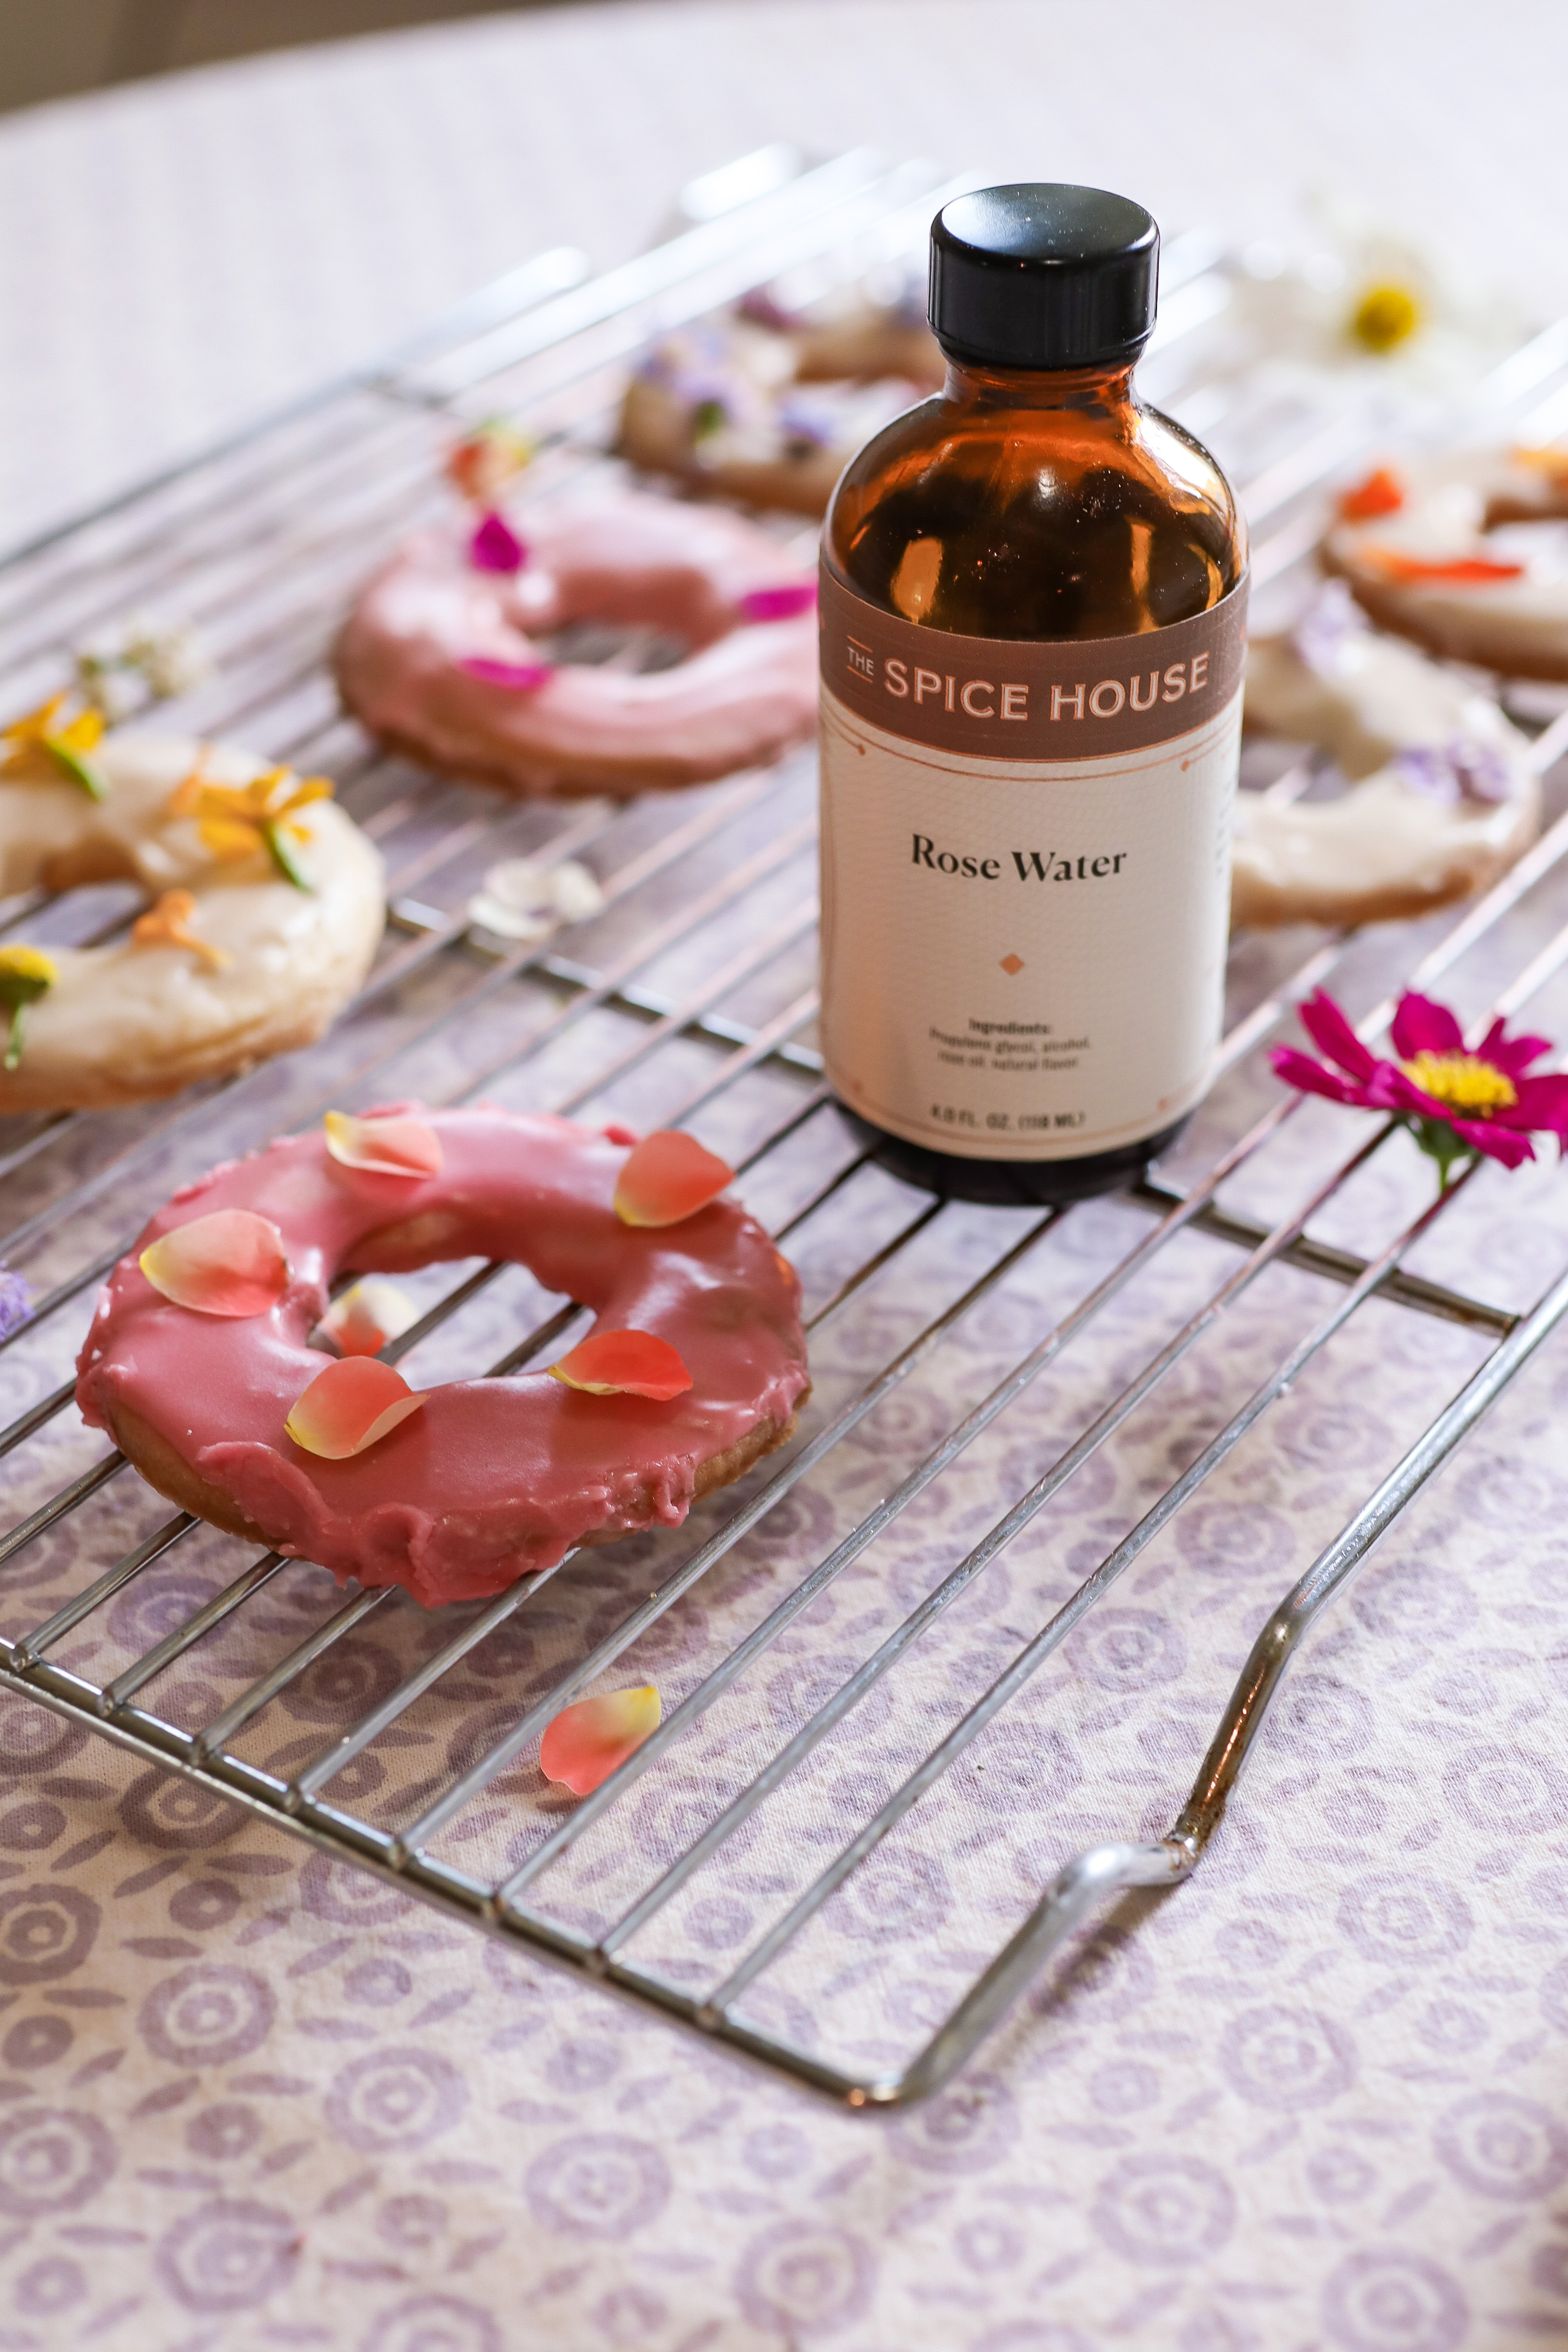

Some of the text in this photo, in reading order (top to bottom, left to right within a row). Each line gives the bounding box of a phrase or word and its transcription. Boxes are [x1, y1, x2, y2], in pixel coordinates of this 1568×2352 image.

[847, 648, 1210, 721] THE SPICE HOUSE
[912, 833, 1128, 882] Rose Water
